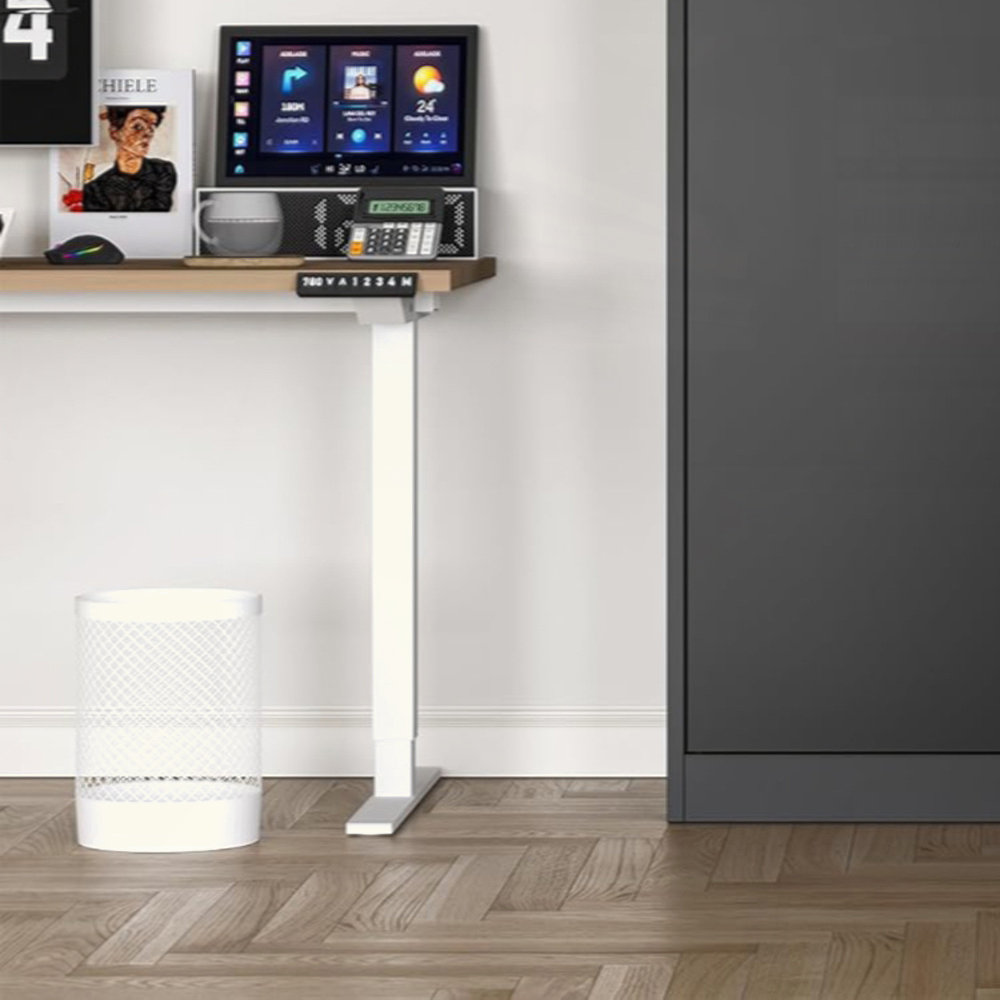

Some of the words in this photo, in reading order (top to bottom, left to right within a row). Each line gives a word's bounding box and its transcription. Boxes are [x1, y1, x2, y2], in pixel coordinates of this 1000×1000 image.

[98, 78, 158, 93] HIELE
[363, 276, 371, 287] 2
[375, 276, 384, 287] 3
